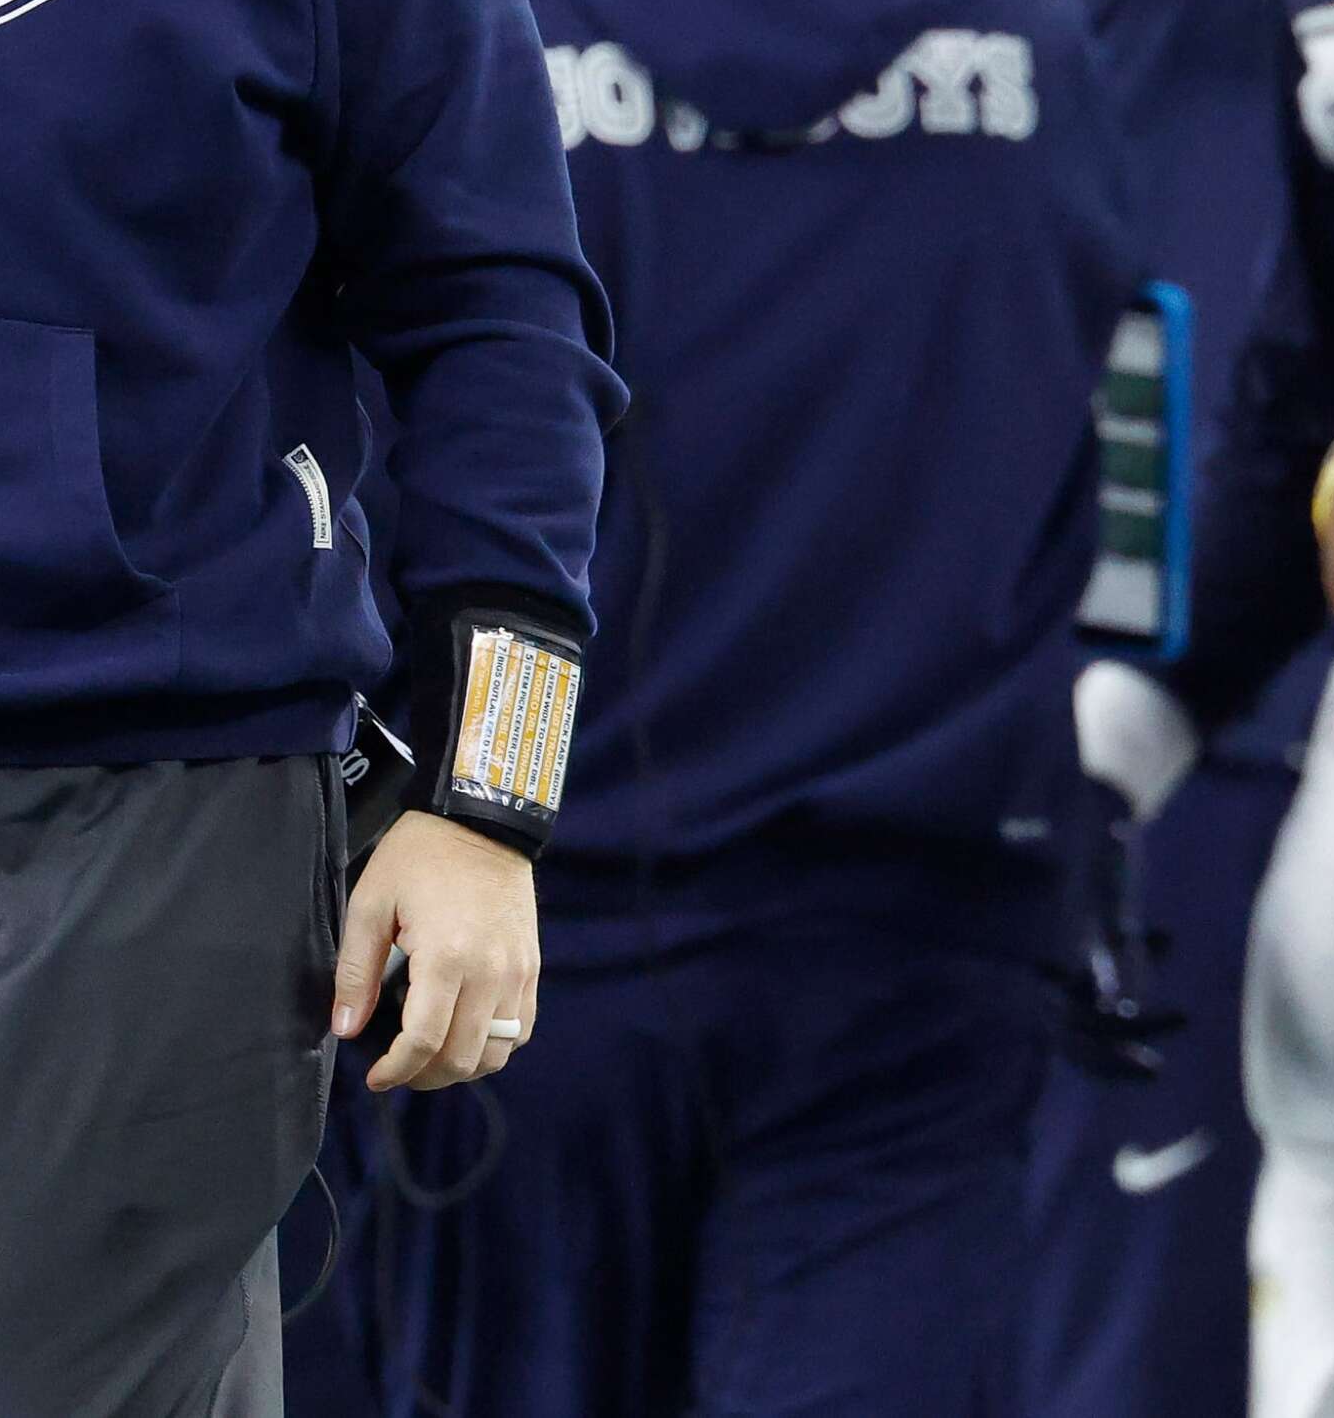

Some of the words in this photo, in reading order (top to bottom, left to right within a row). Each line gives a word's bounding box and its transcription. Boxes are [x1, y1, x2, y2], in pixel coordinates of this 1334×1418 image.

[544, 28, 1039, 152] OOYS
[525, 653, 534, 661] 5
[521, 663, 531, 689] STEM
[545, 672, 555, 699] STEM
[517, 690, 526, 711] PICK
[566, 682, 576, 710] EVEN
[540, 700, 550, 724] WIDE
[561, 712, 571, 737] PICK
[510, 713, 522, 749] CENTER
[537, 726, 545, 740] TO
[556, 738, 566, 767] EASY
